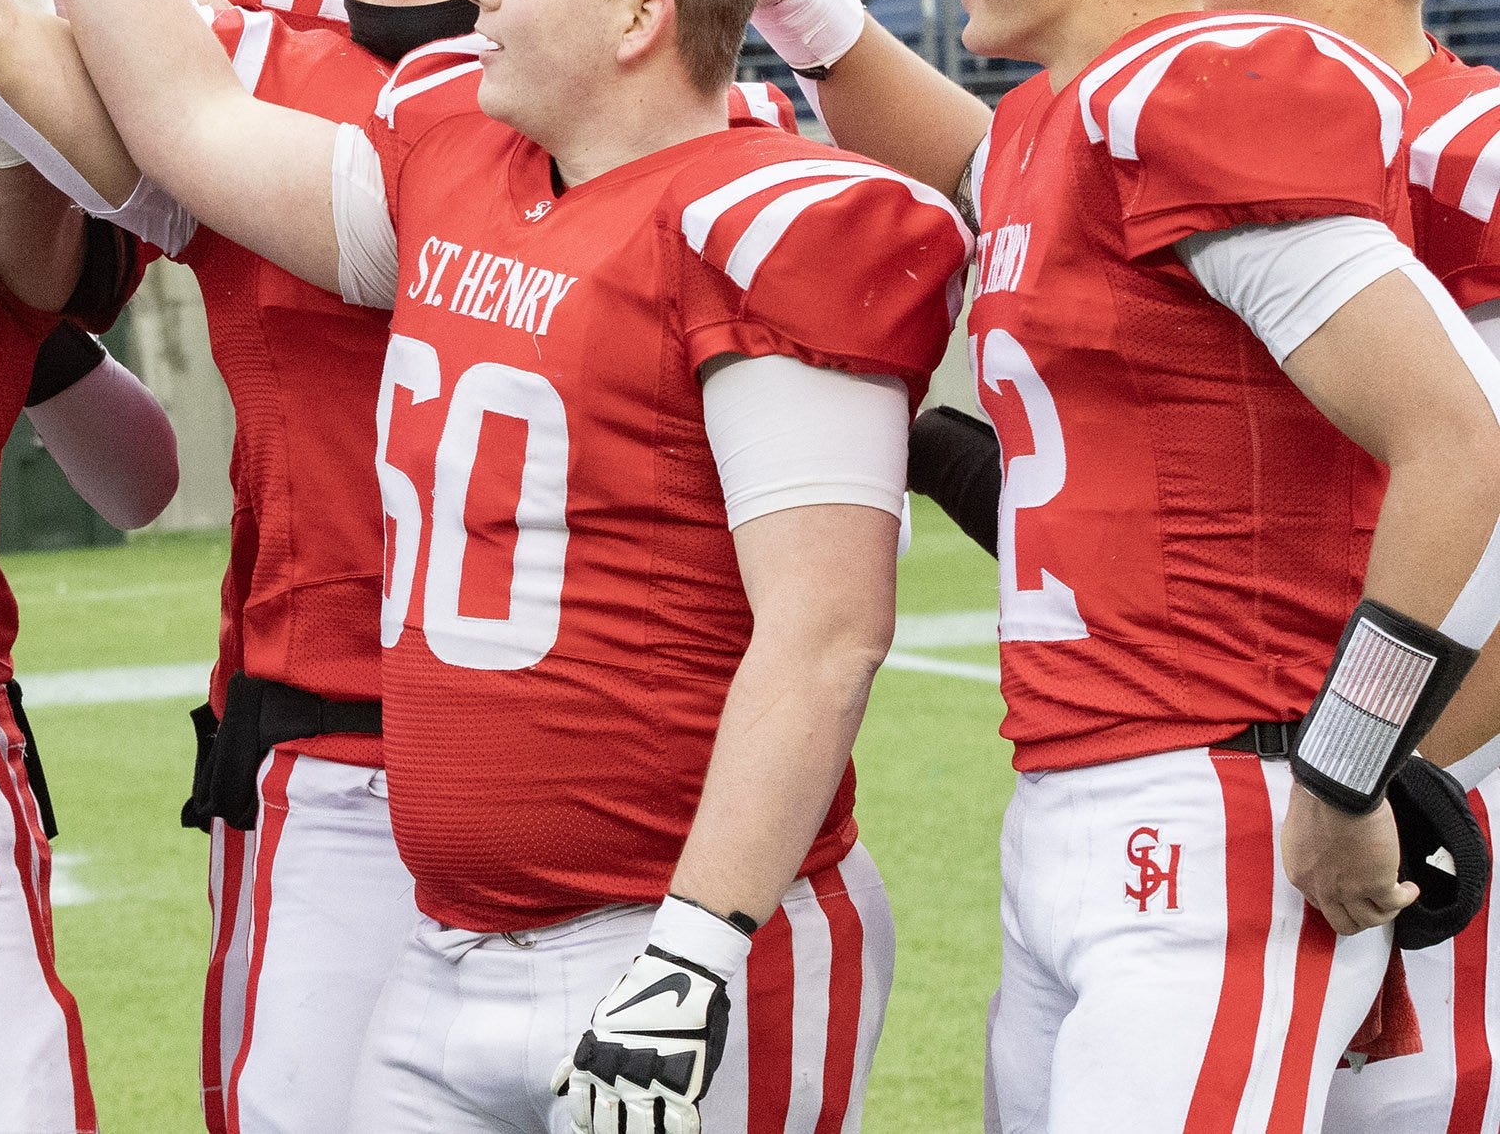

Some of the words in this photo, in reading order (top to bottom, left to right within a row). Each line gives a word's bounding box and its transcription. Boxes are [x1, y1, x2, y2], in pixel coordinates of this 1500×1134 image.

[406, 235, 463, 307] ST.
[448, 250, 579, 336] HENRY
[375, 333, 570, 671] 60
[969, 328, 1091, 643] 2
